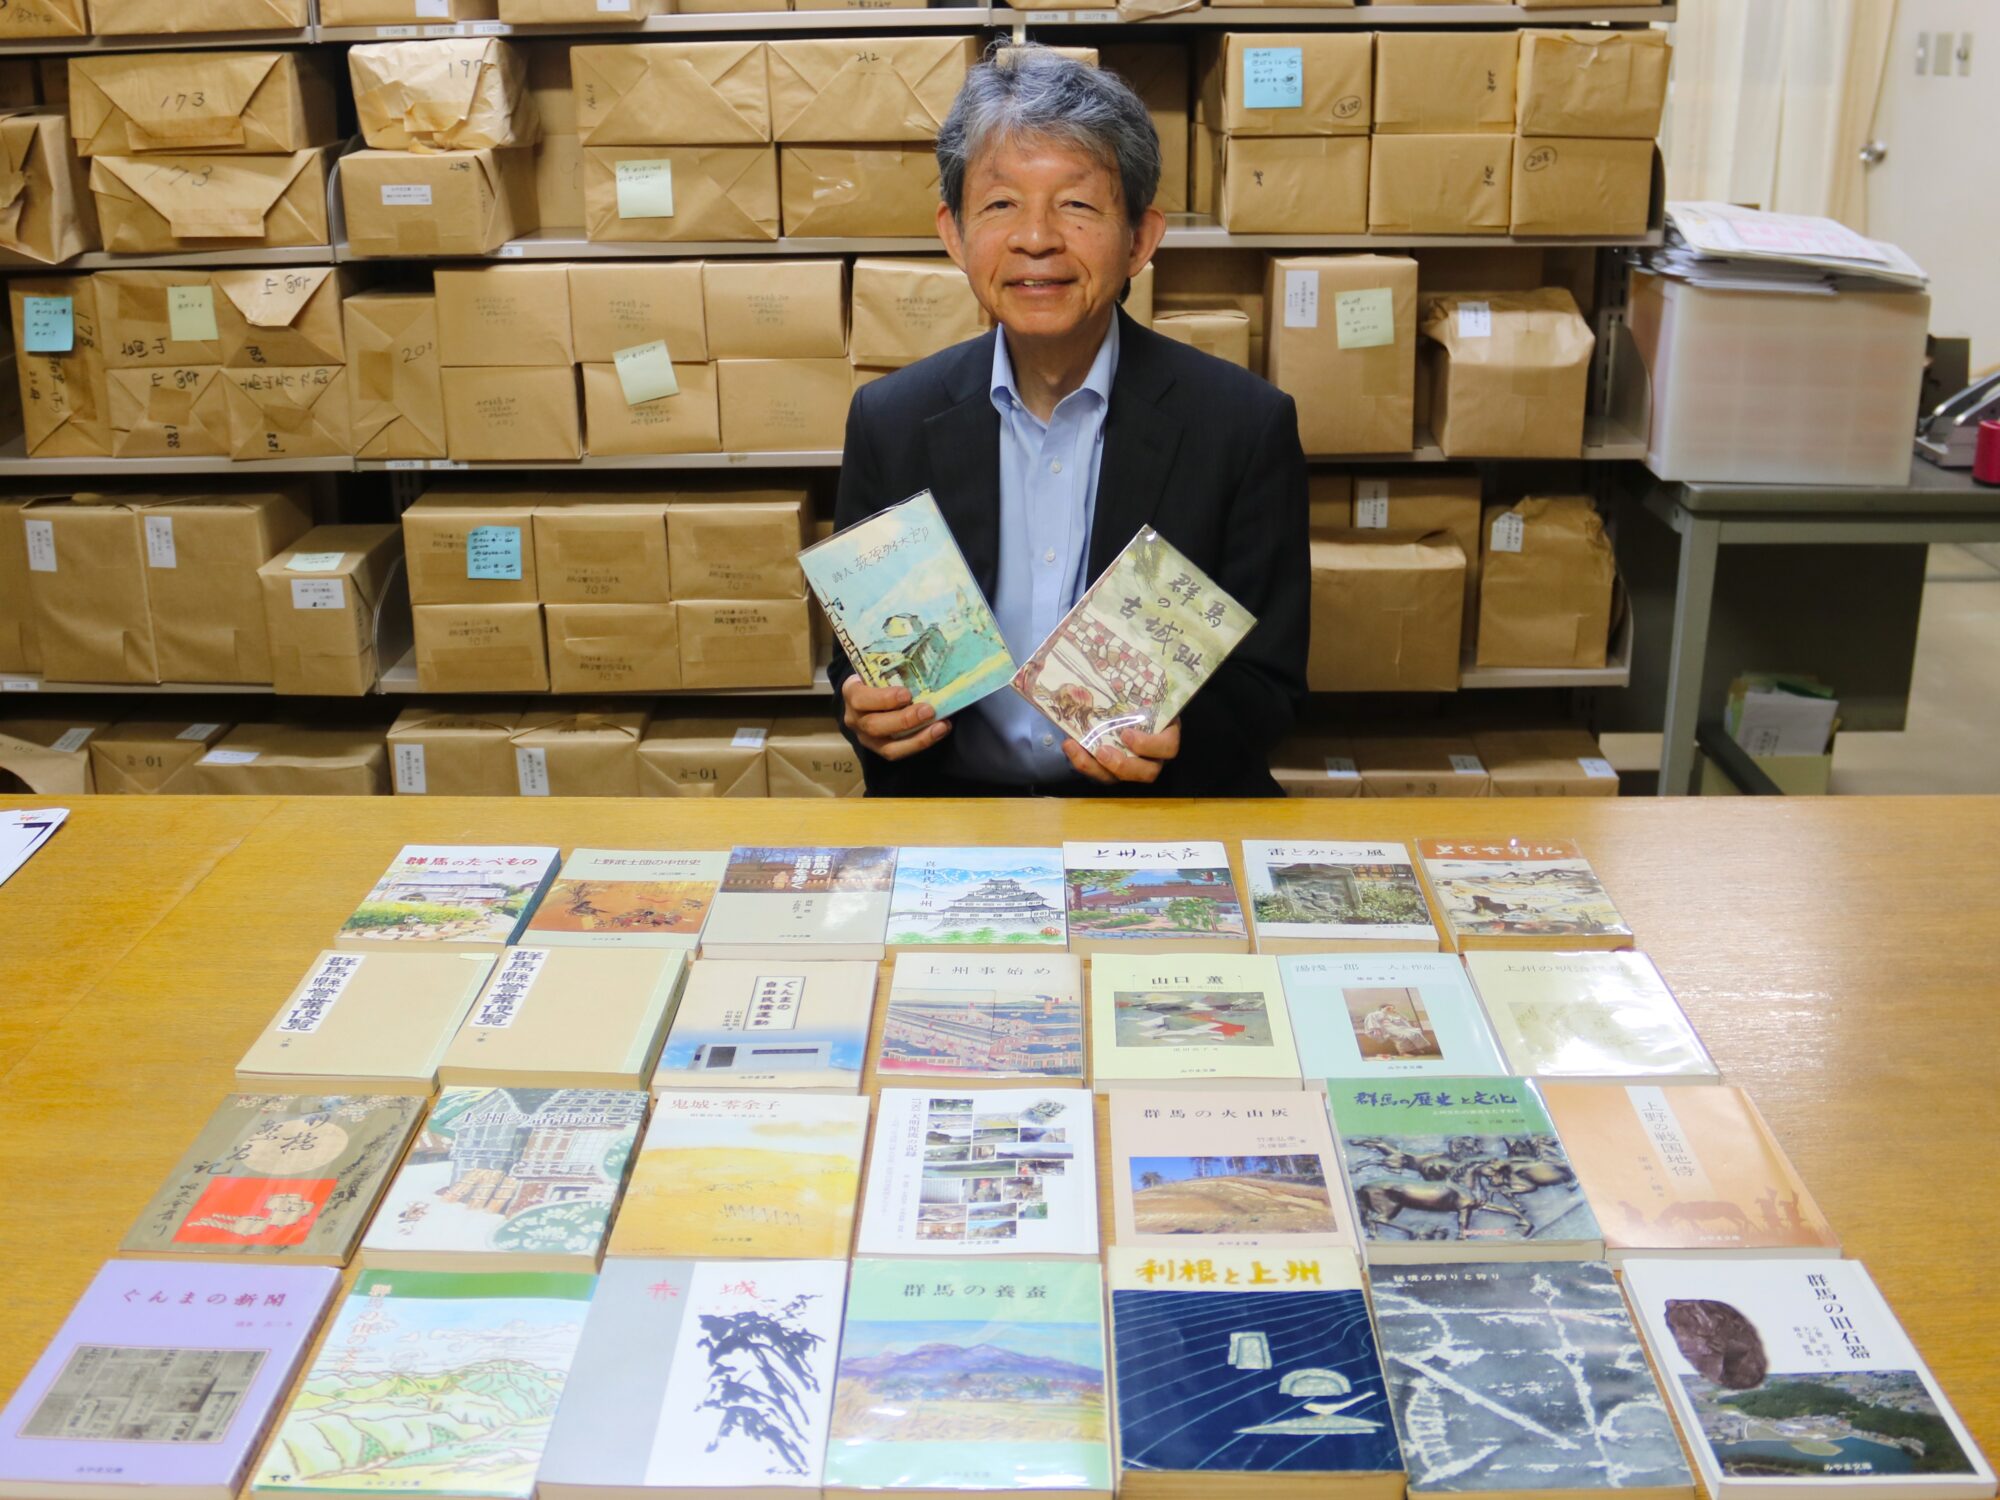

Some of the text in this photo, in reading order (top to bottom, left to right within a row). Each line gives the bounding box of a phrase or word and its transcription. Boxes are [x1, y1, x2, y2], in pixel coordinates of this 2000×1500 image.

[160, 91, 206, 112] 173
[146, 164, 213, 187] 173
[1157, 596, 1171, 609] の
[1167, 572, 1228, 629] 群馬
[404, 856, 538, 867] 群馬のたべもの
[923, 965, 1052, 977] 上州事始め
[1151, 975, 1190, 985] 山口
[776, 980, 799, 1011] ぐんまの
[1353, 1091, 1518, 1108] 群馬の歴史と文化
[1143, 1108, 1289, 1119] 群馬の火山灰
[1135, 1258, 1323, 1285] 利根と上州
[122, 1288, 287, 1307] ぐんまの新聞
[903, 1284, 1048, 1299] 群馬の養蚕
[1806, 1273, 1871, 1360] 群馬の旧石器
